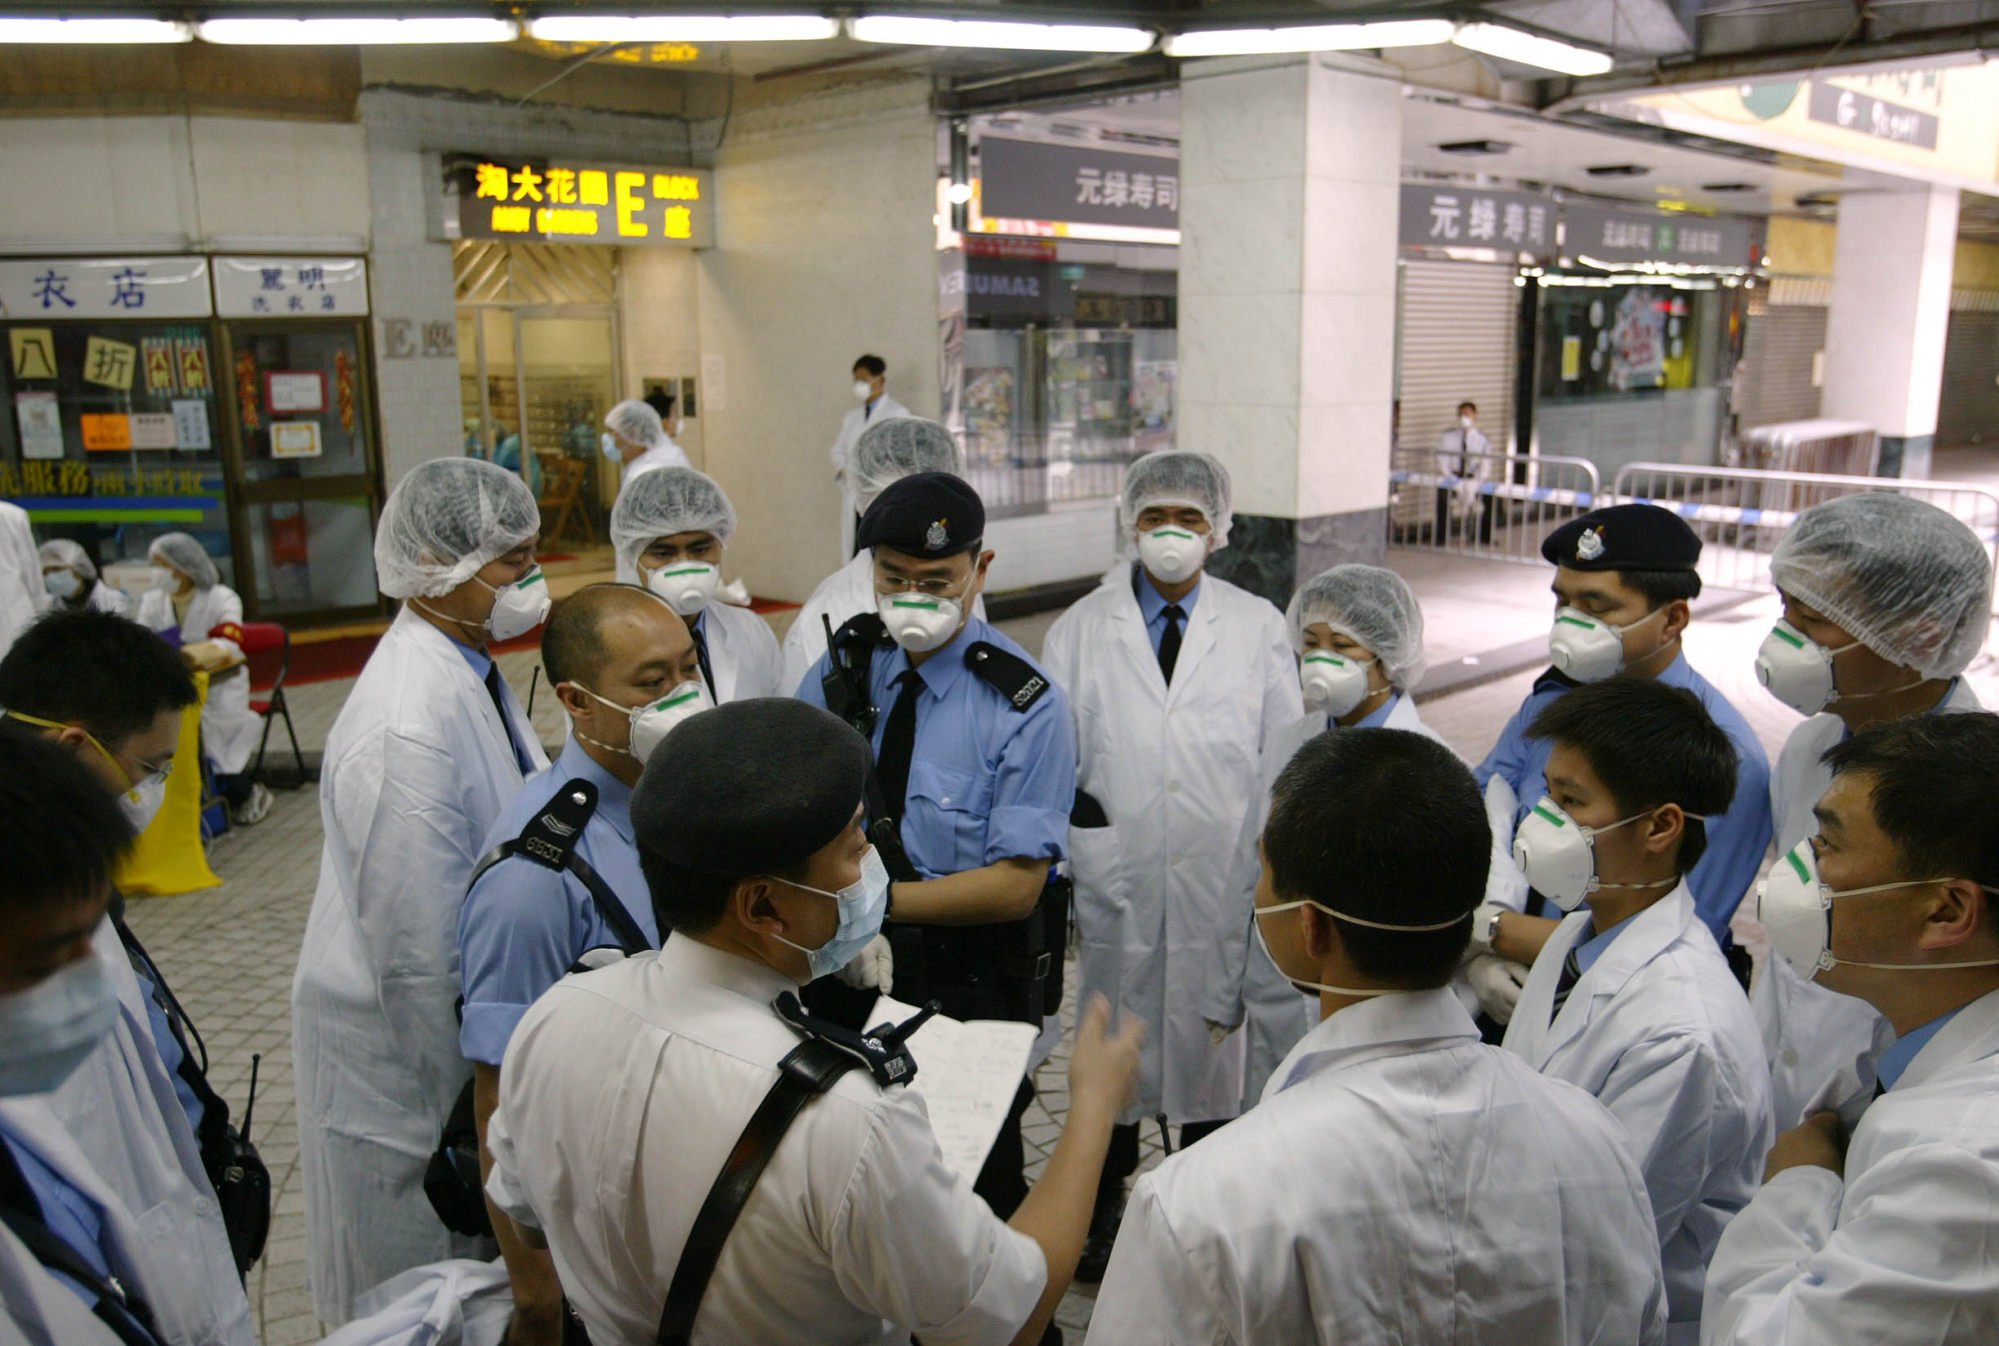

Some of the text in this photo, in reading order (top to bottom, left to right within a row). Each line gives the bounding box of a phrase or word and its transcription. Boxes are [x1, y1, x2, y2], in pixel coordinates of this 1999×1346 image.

[615, 171, 648, 237] E
[0, 267, 148, 309] 衣店
[17, 338, 130, 386] 八 折
